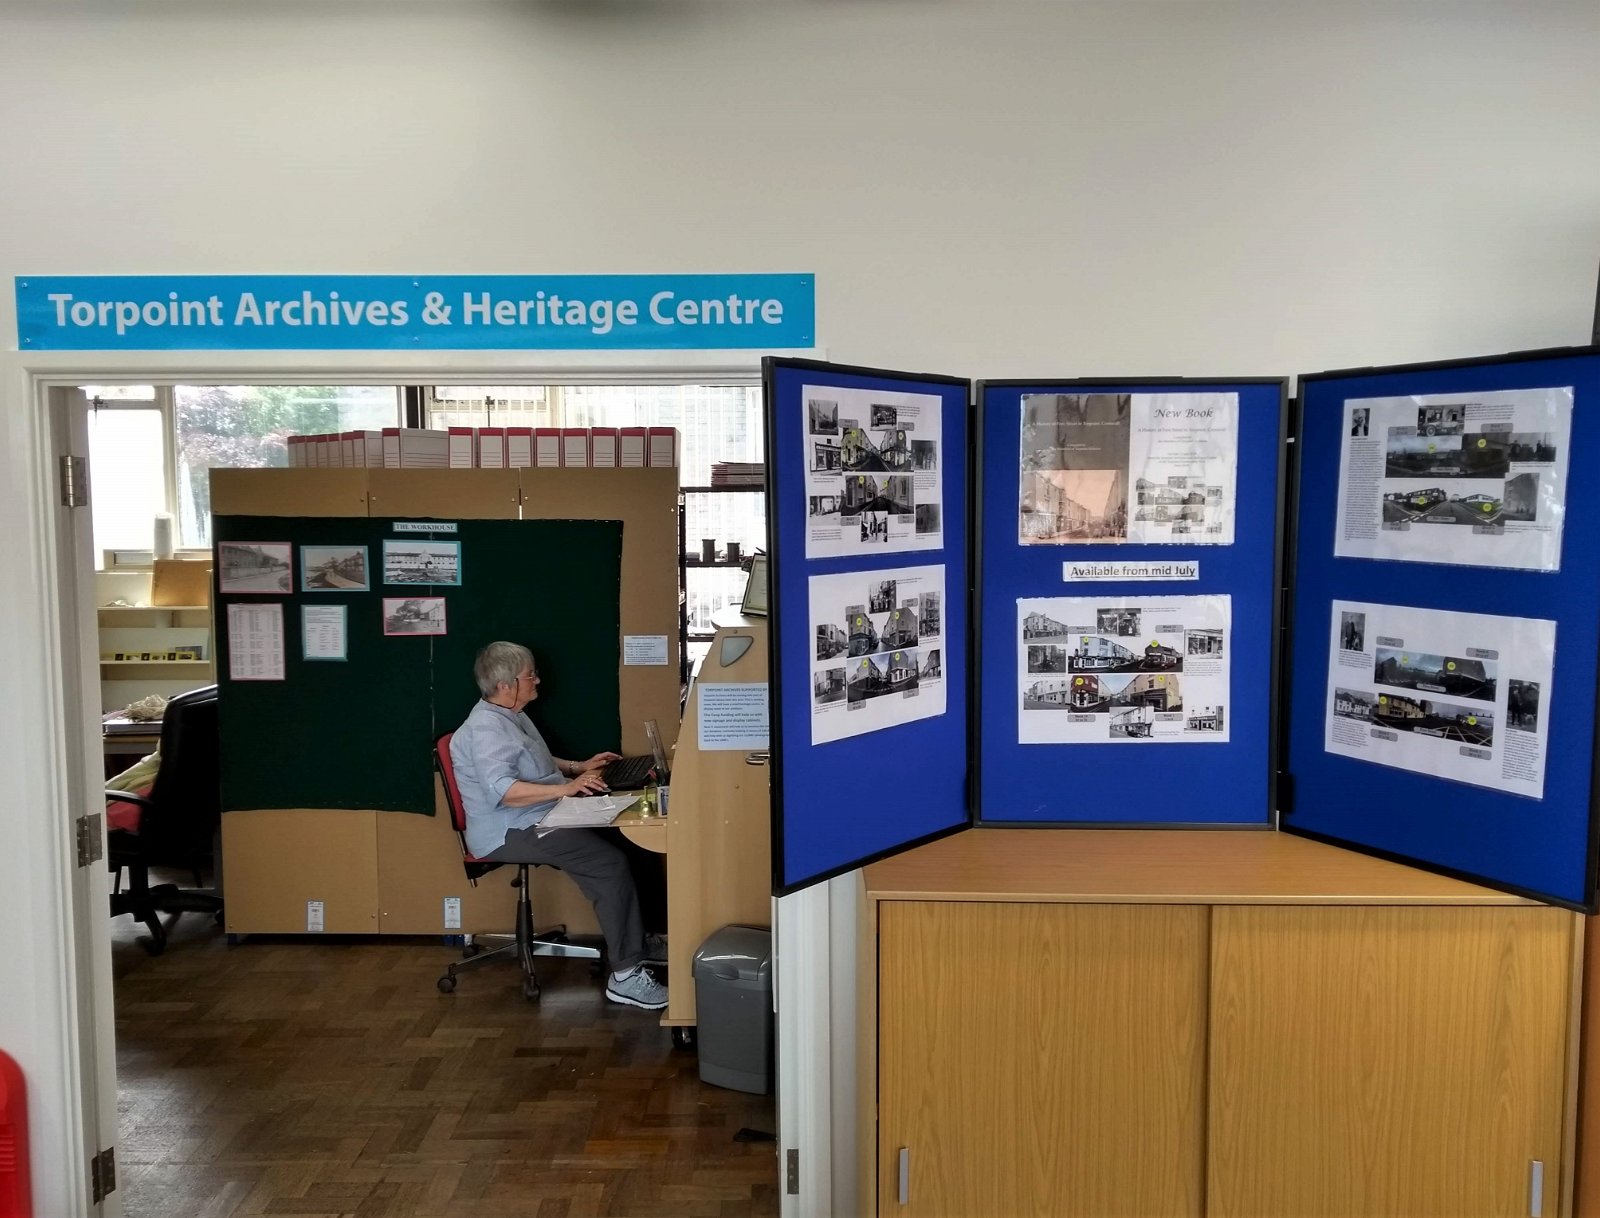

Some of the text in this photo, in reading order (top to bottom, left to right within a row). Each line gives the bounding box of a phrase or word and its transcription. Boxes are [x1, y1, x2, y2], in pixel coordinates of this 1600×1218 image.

[48, 291, 783, 335] Torpoint Archives & Heritage Centre
[1154, 407, 1214, 418] New Book
[1071, 565, 1196, 578] Available from mid July
